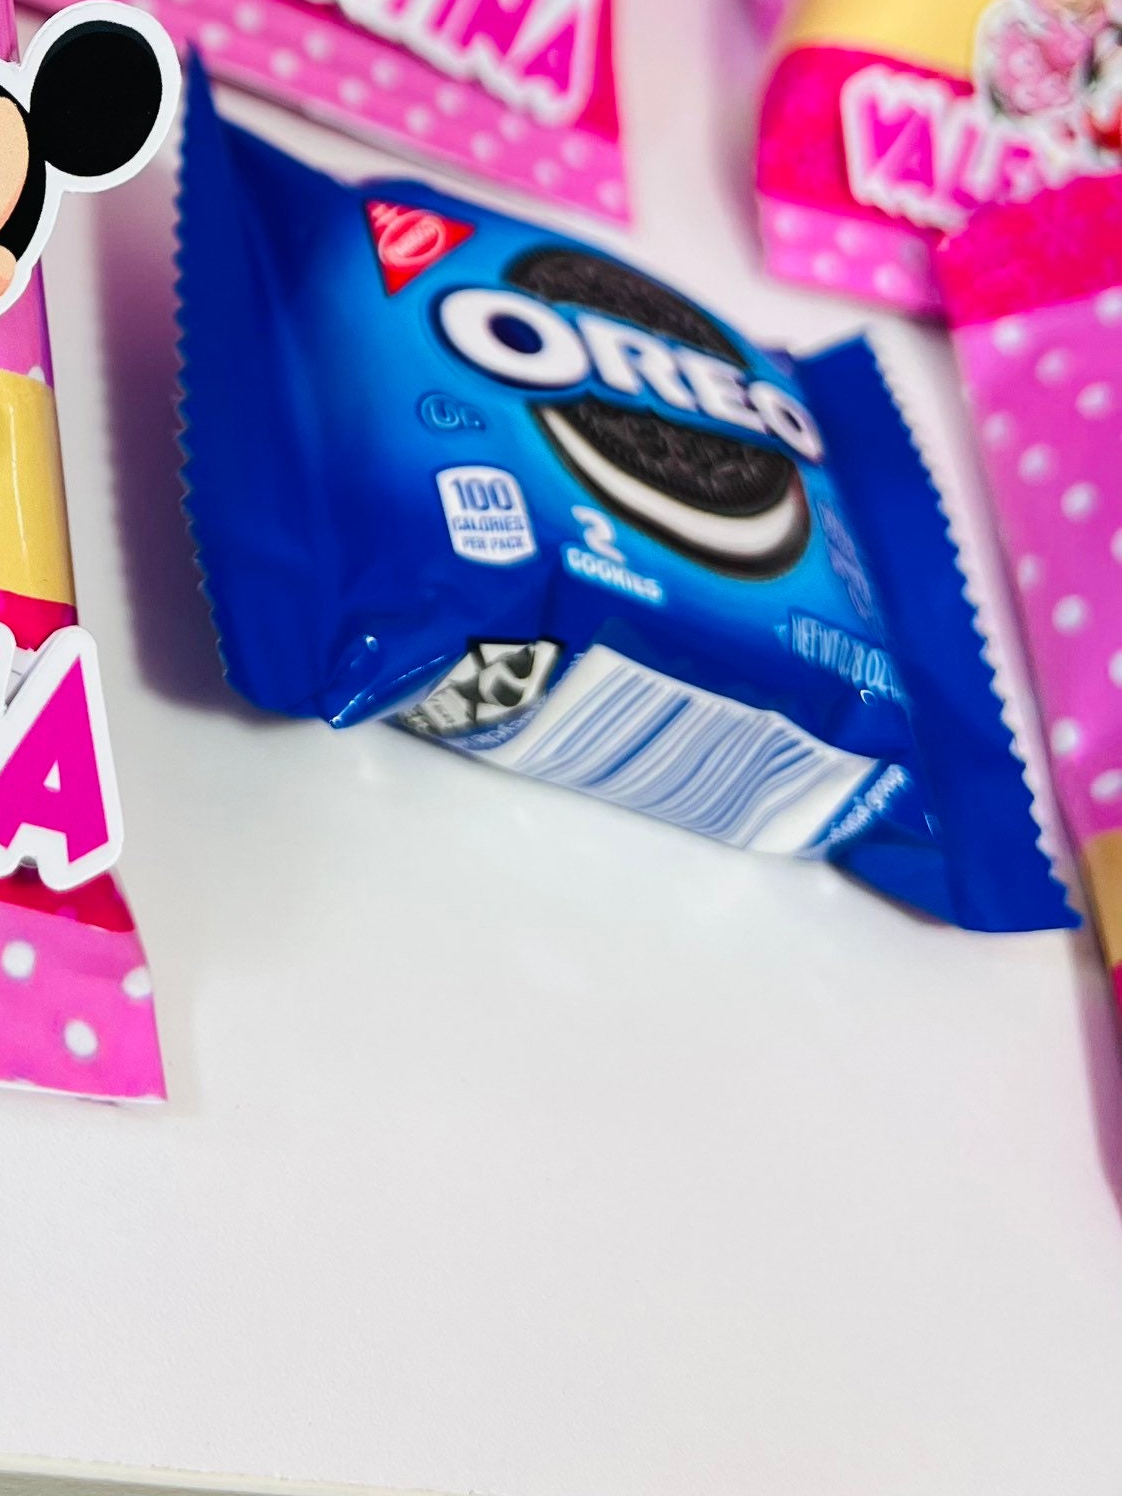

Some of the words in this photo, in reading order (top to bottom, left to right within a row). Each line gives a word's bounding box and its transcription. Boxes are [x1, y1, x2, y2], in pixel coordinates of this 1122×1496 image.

[439, 288, 824, 464] OREO
[451, 477, 514, 512] 100
[570, 504, 626, 565] 2
[566, 547, 664, 602] COOKIES
